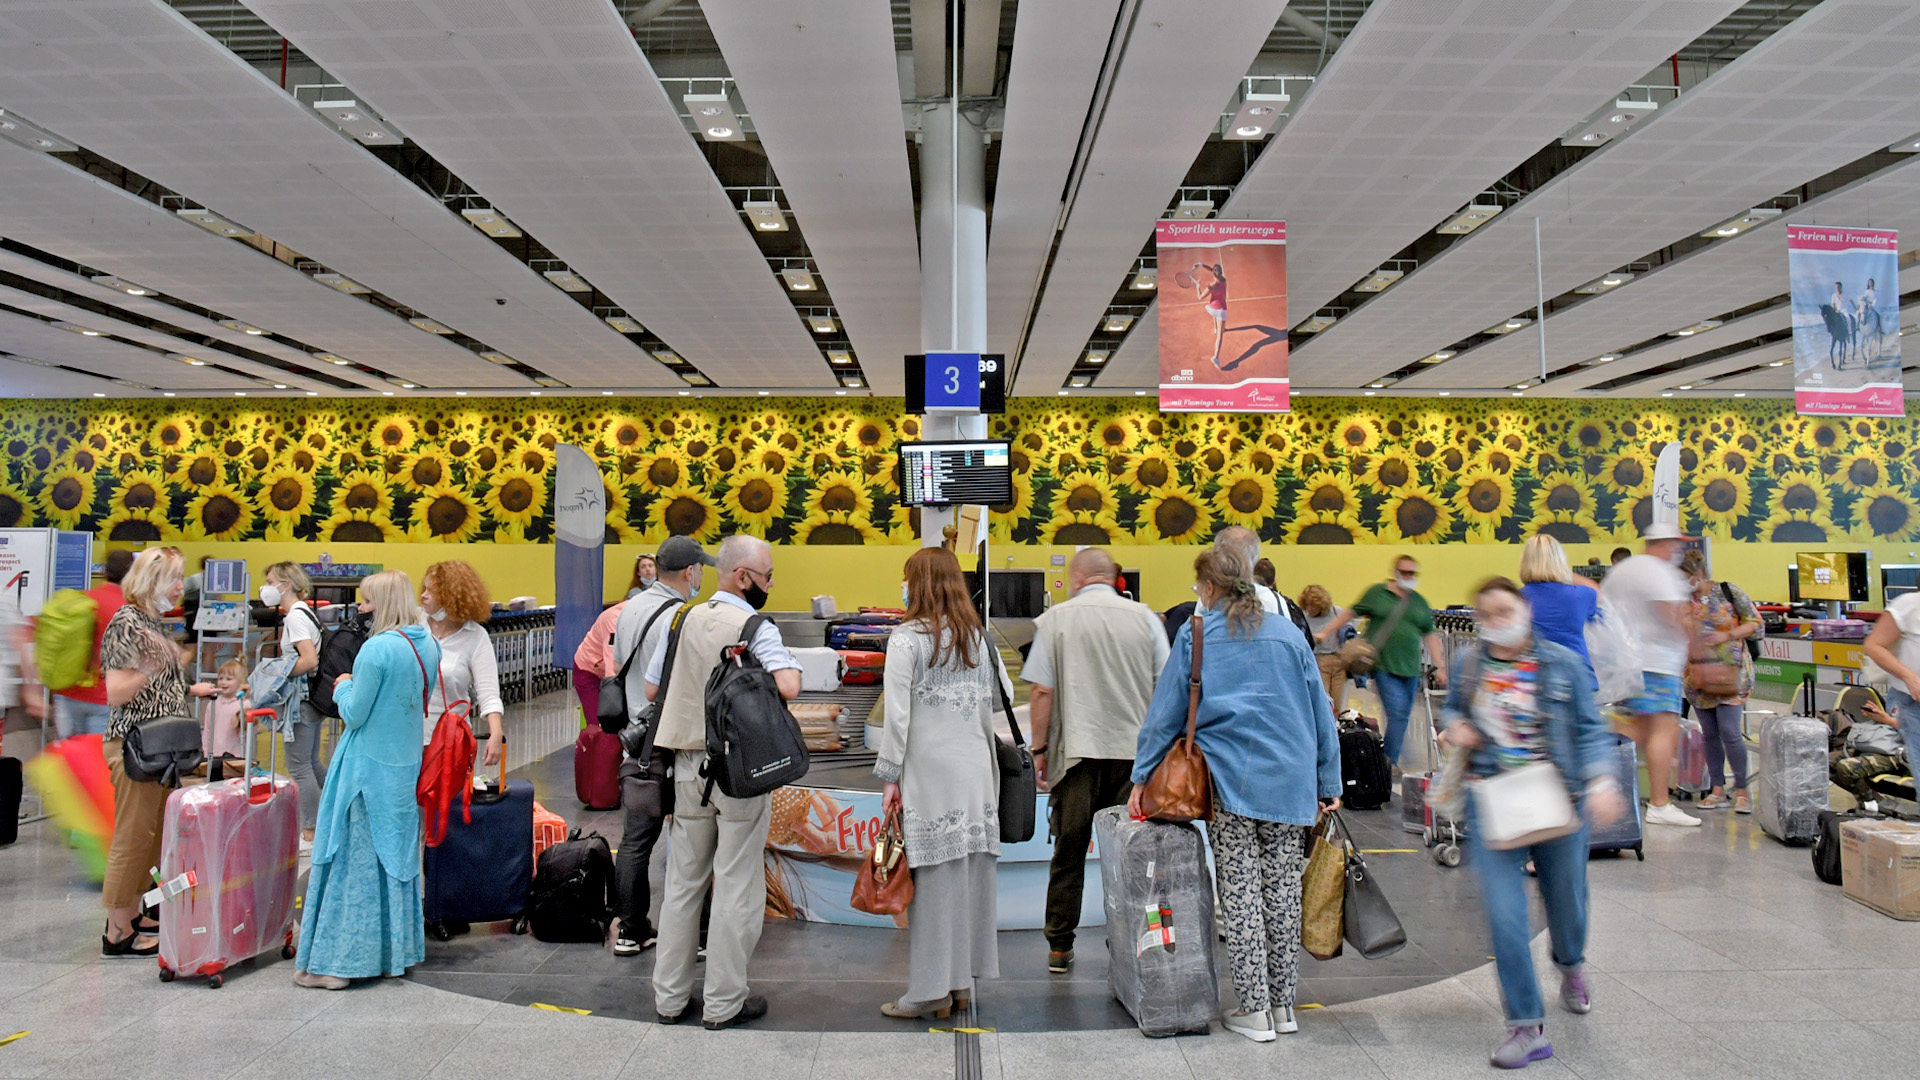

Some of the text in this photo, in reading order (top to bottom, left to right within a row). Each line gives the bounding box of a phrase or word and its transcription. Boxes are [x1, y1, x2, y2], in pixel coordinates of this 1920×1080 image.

[1168, 223, 1275, 237] Sportlich unterwegs
[1798, 231, 1888, 244] Ferien mit Freunden
[943, 366, 960, 395] 3
[1184, 399, 1215, 408] Flamingo
[1815, 402, 1840, 410] Flamingo
[1841, 402, 1857, 410] Tours
[1763, 639, 1791, 659] Mall
[1847, 650, 1863, 663] NIC
[1754, 663, 1782, 677] NMENTS
[836, 804, 882, 854] Fre
